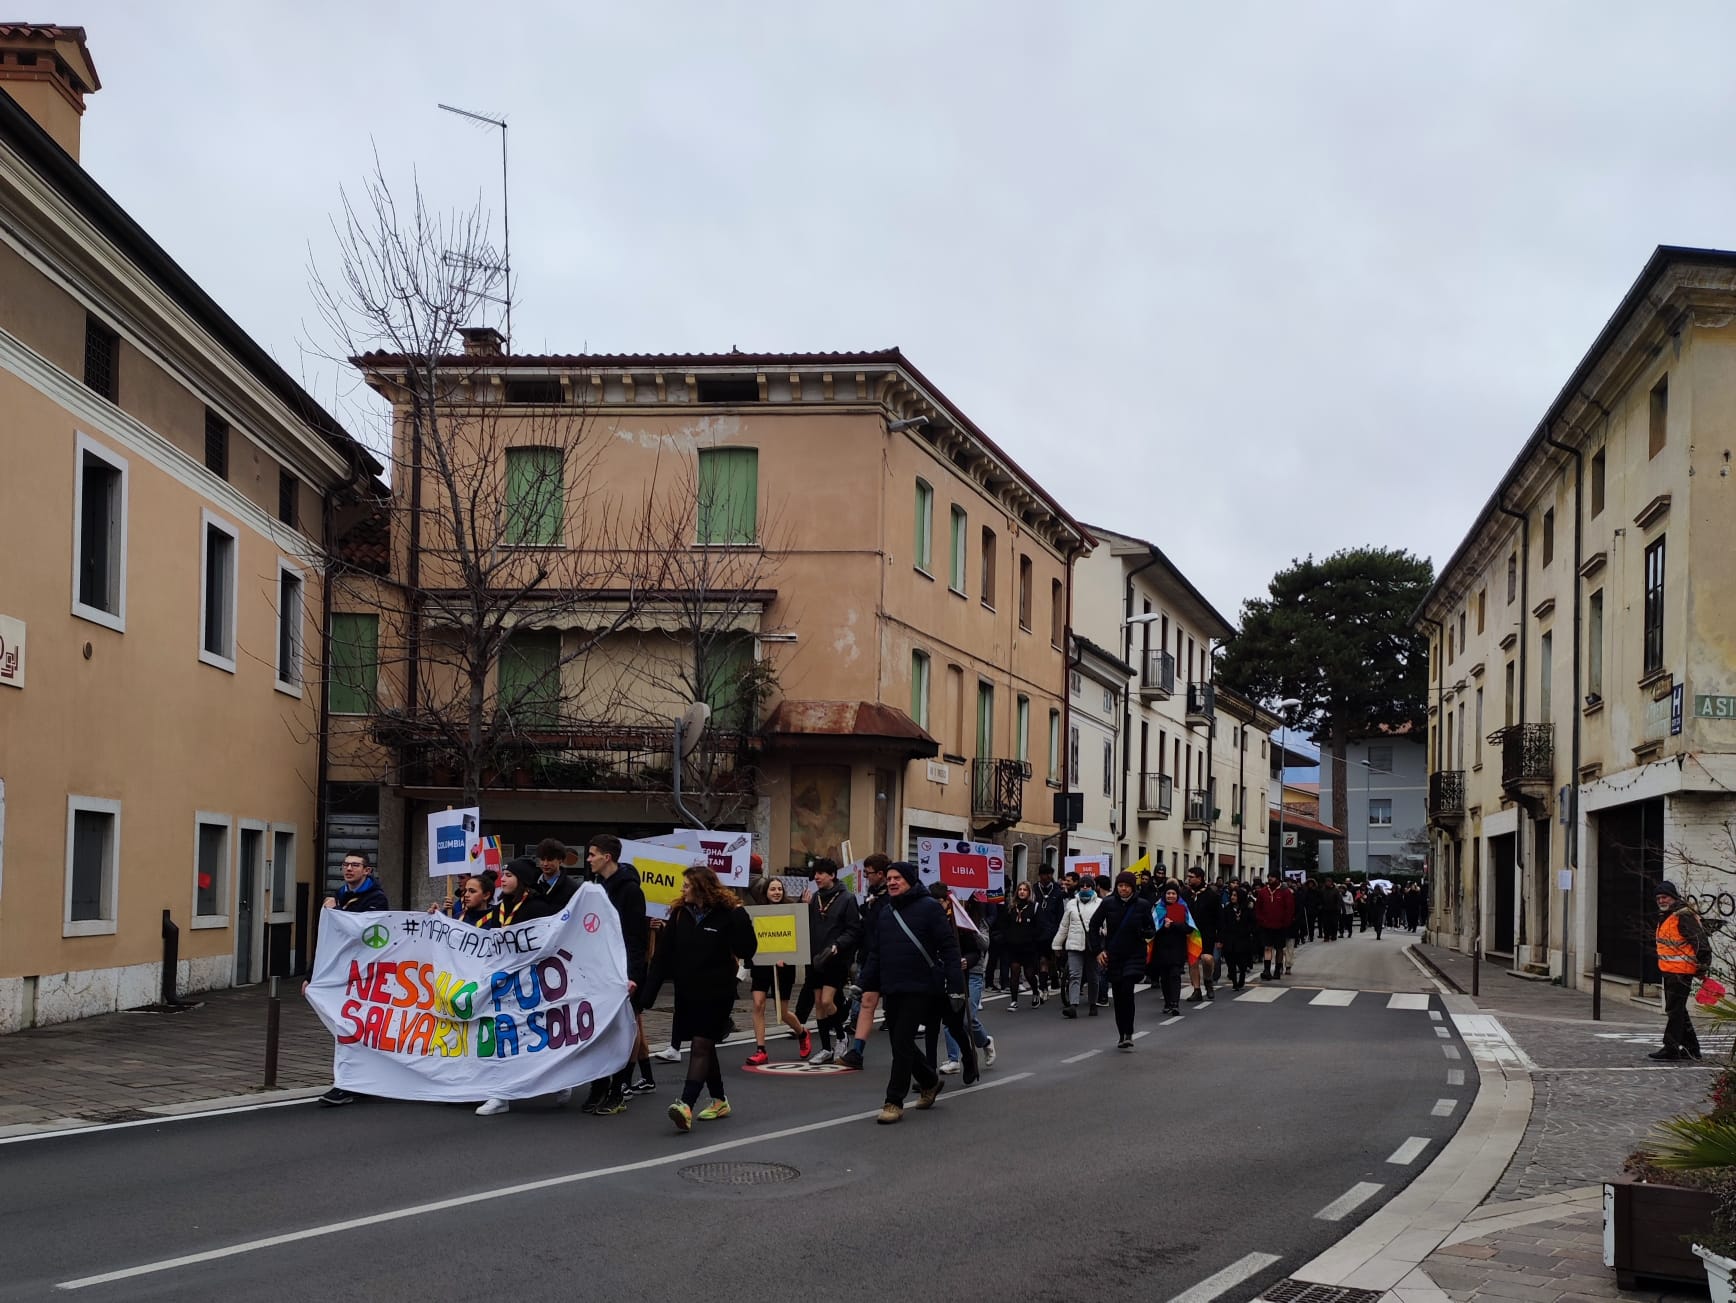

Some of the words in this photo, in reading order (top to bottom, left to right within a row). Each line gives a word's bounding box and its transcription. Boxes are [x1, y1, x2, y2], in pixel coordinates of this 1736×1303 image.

[1672, 687, 1682, 717] H
[437, 839, 465, 850] COLOMBIA
[951, 865, 976, 876] LIBIA
[641, 870, 675, 888] IRAN
[757, 930, 793, 939] MYANMAR
[476, 1013, 519, 1059] DA
[527, 1000, 596, 1056] SOLO
